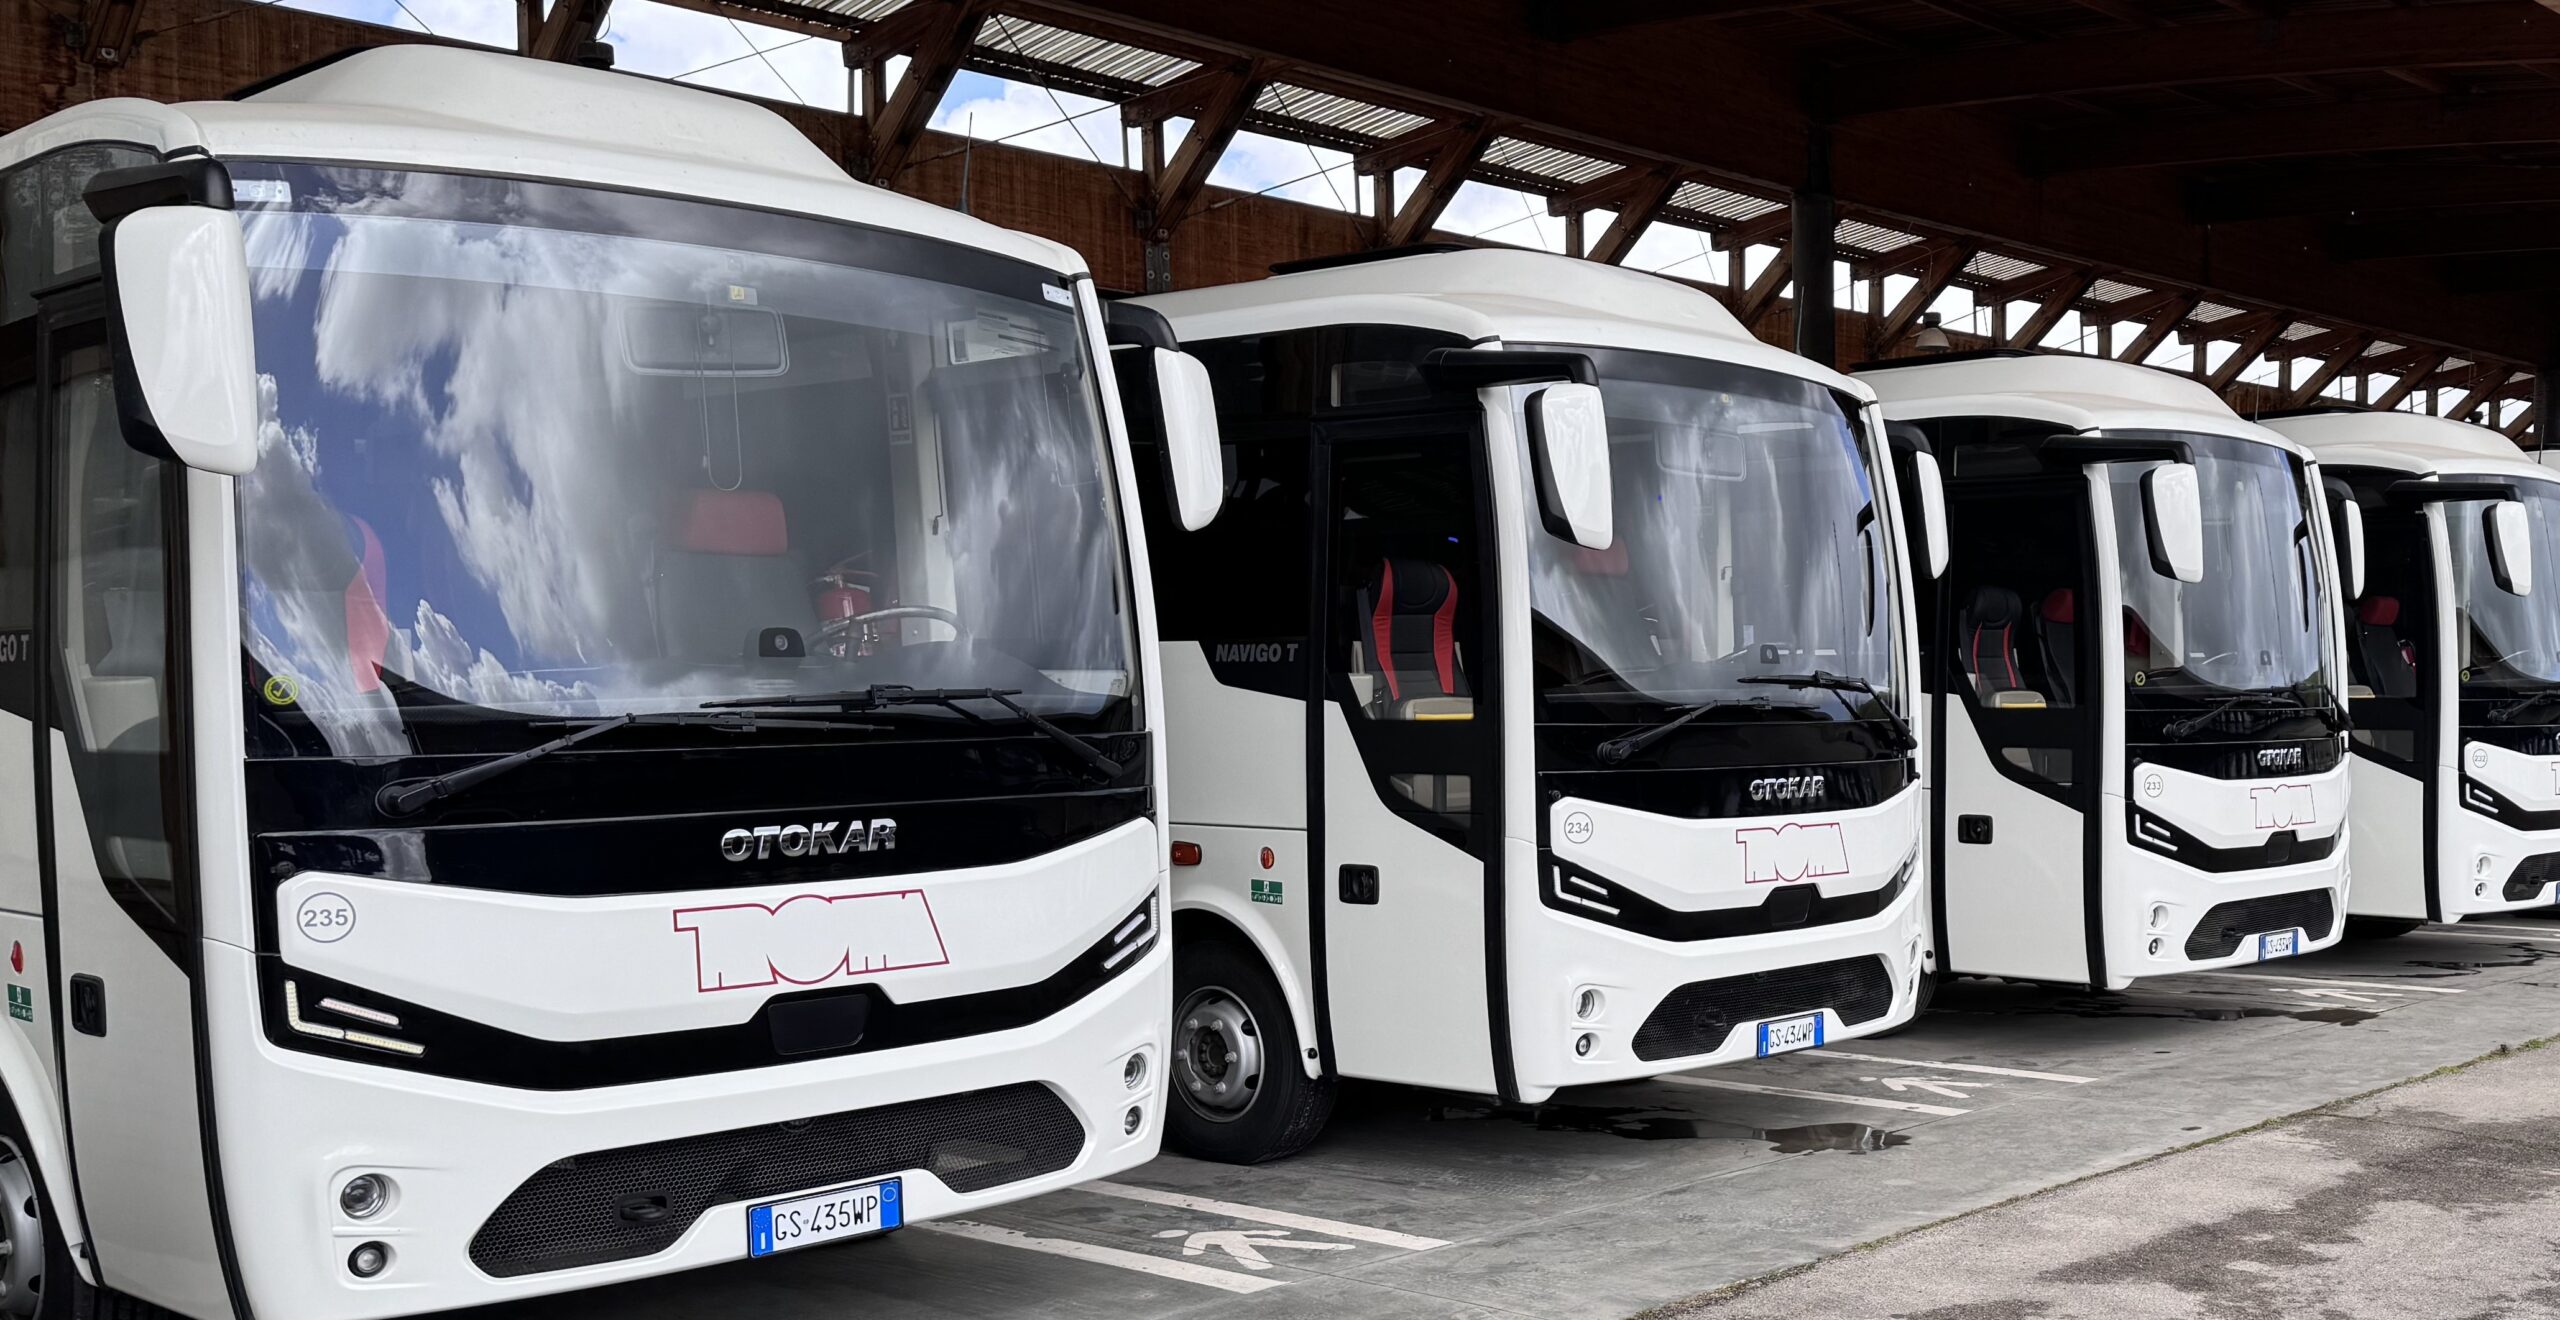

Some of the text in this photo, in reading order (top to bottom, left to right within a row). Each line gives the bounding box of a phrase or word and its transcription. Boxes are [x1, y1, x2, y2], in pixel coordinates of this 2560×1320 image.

[21, 634, 30, 661] T
[1216, 643, 1299, 662] NAVIGO T
[2257, 747, 2302, 766] OTOKAR
[1749, 775, 1824, 801] OTOKAR
[2146, 781, 2161, 790] 233
[1567, 822, 1589, 834] 234
[721, 818, 897, 862] OTOKAR
[303, 908, 348, 928] 235
